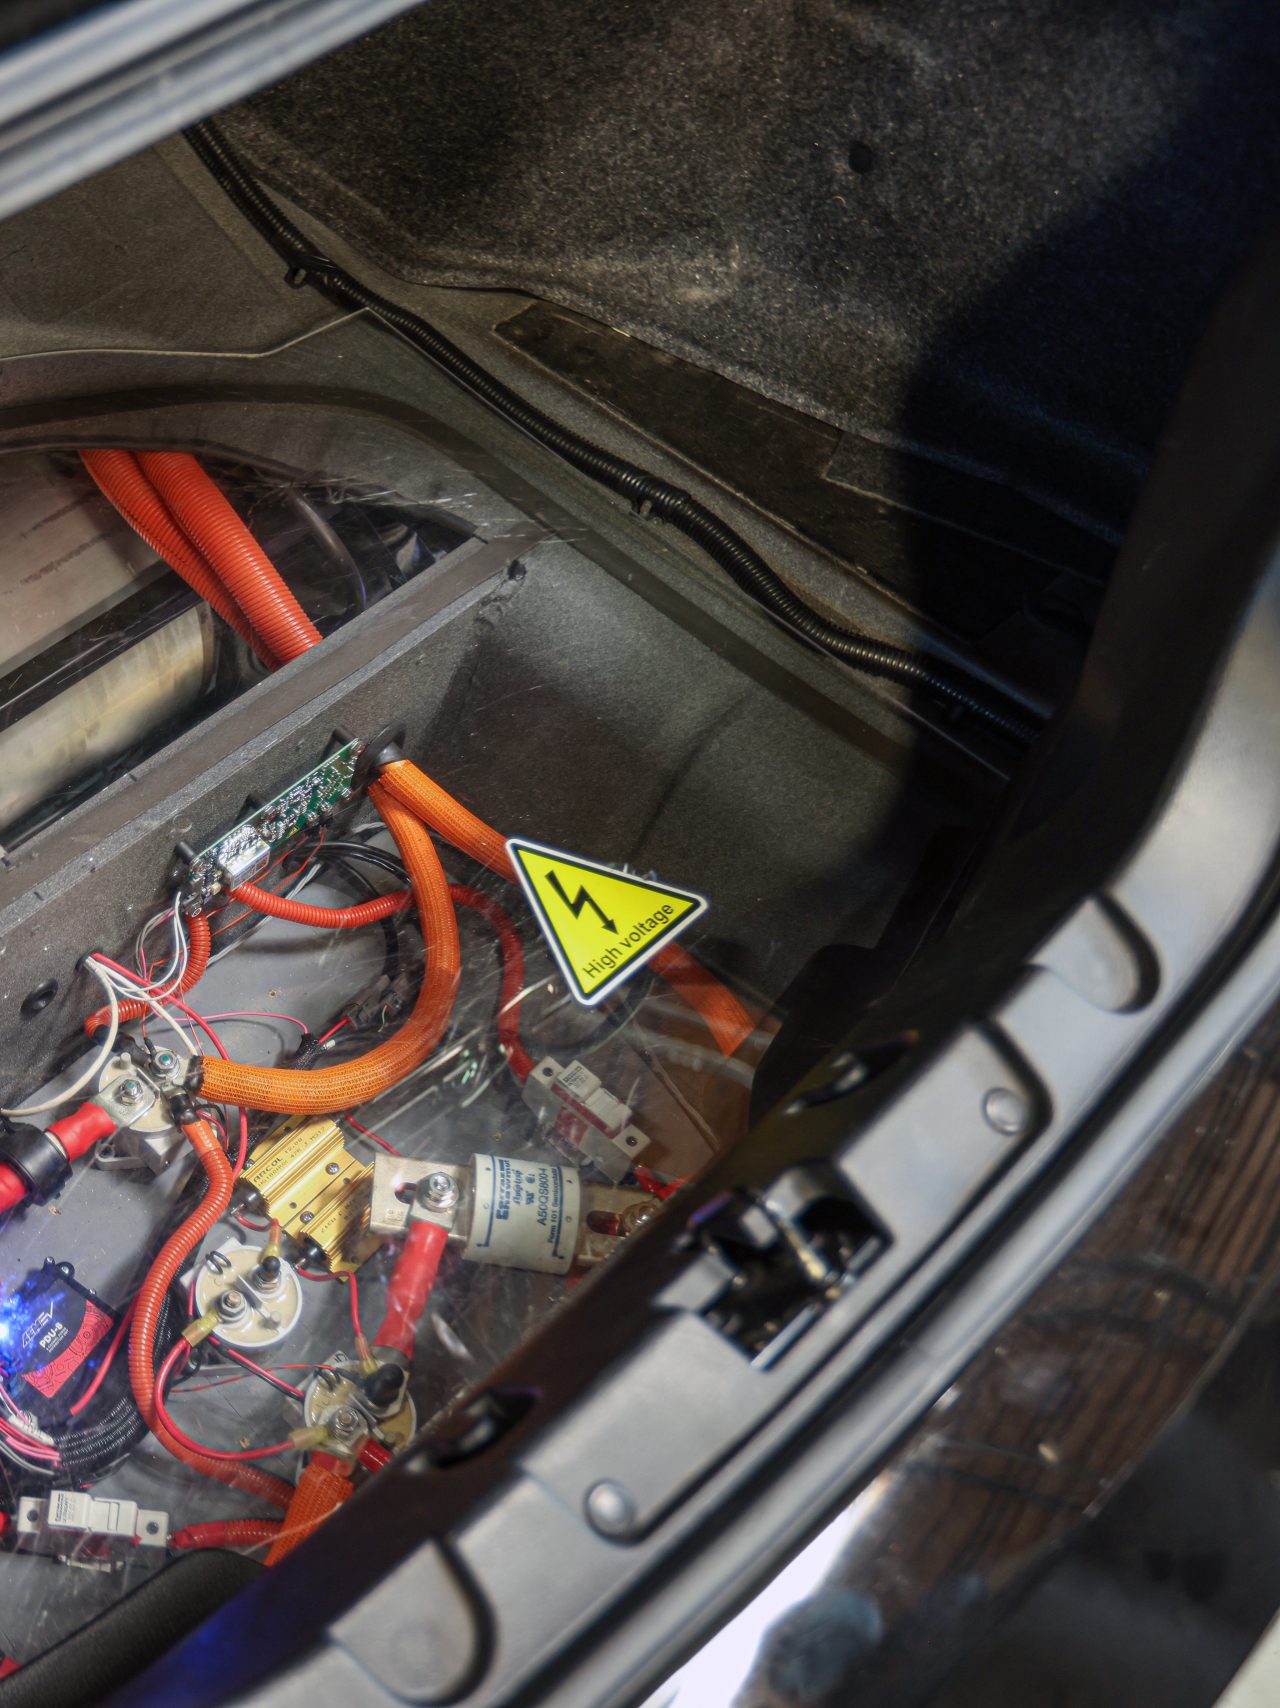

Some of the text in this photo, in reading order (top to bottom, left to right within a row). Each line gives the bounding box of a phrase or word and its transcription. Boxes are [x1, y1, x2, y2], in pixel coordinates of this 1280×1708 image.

[583, 904, 674, 979] High voltage
[40, 1322, 63, 1348] PDU-8
